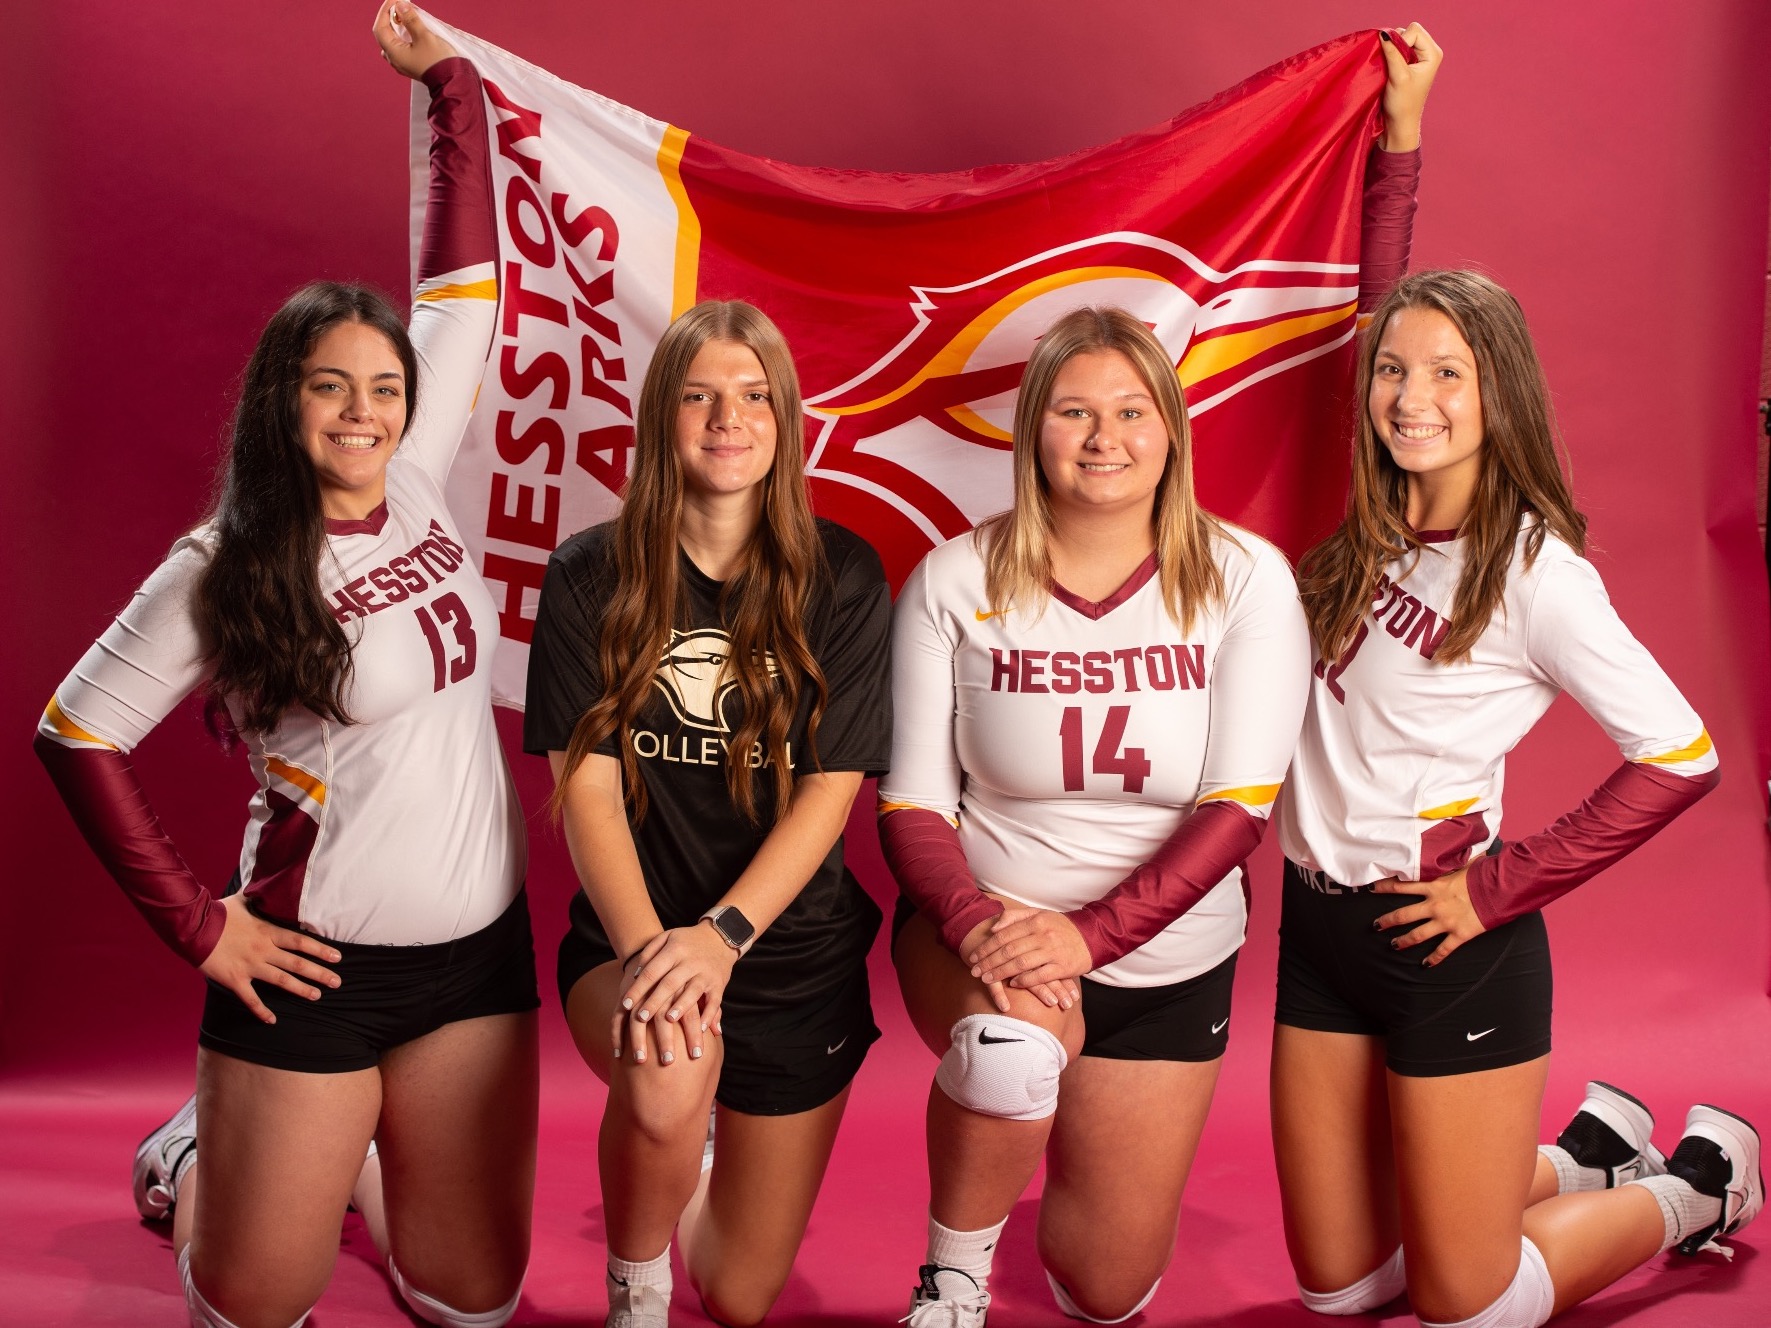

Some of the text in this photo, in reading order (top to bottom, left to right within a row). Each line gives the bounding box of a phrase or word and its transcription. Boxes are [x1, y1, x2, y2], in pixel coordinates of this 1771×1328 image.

[482, 77, 570, 645] HESSTON
[551, 192, 637, 538] ARKS
[324, 518, 464, 625] HESSTON
[414, 591, 477, 693] 13
[989, 644, 1206, 694] HESSTON
[1059, 705, 1151, 794] 14
